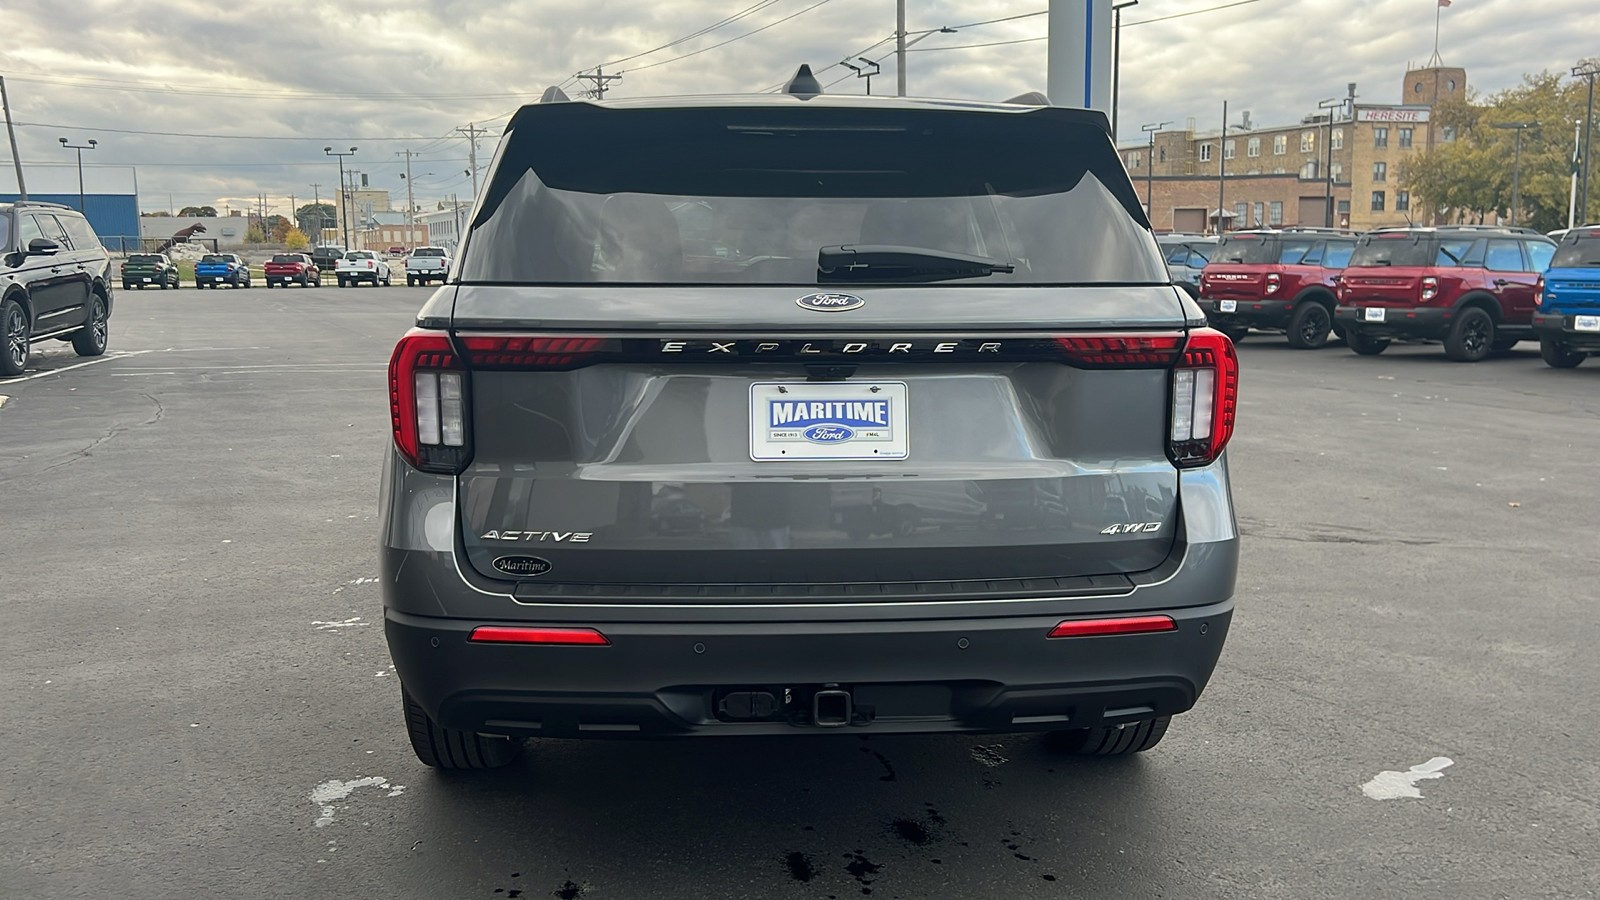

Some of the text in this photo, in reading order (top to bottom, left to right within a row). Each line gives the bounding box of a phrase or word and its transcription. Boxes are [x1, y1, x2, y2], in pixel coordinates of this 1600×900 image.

[1365, 111, 1418, 120] HERESITE
[812, 293, 849, 307] Ford
[661, 342, 1002, 353] EXPLORER
[772, 402, 887, 426] MARITIME
[812, 428, 845, 440] Ford
[1100, 522, 1161, 535] 4WD
[480, 529, 593, 543] ACTIVE
[499, 559, 546, 571] Maritime
